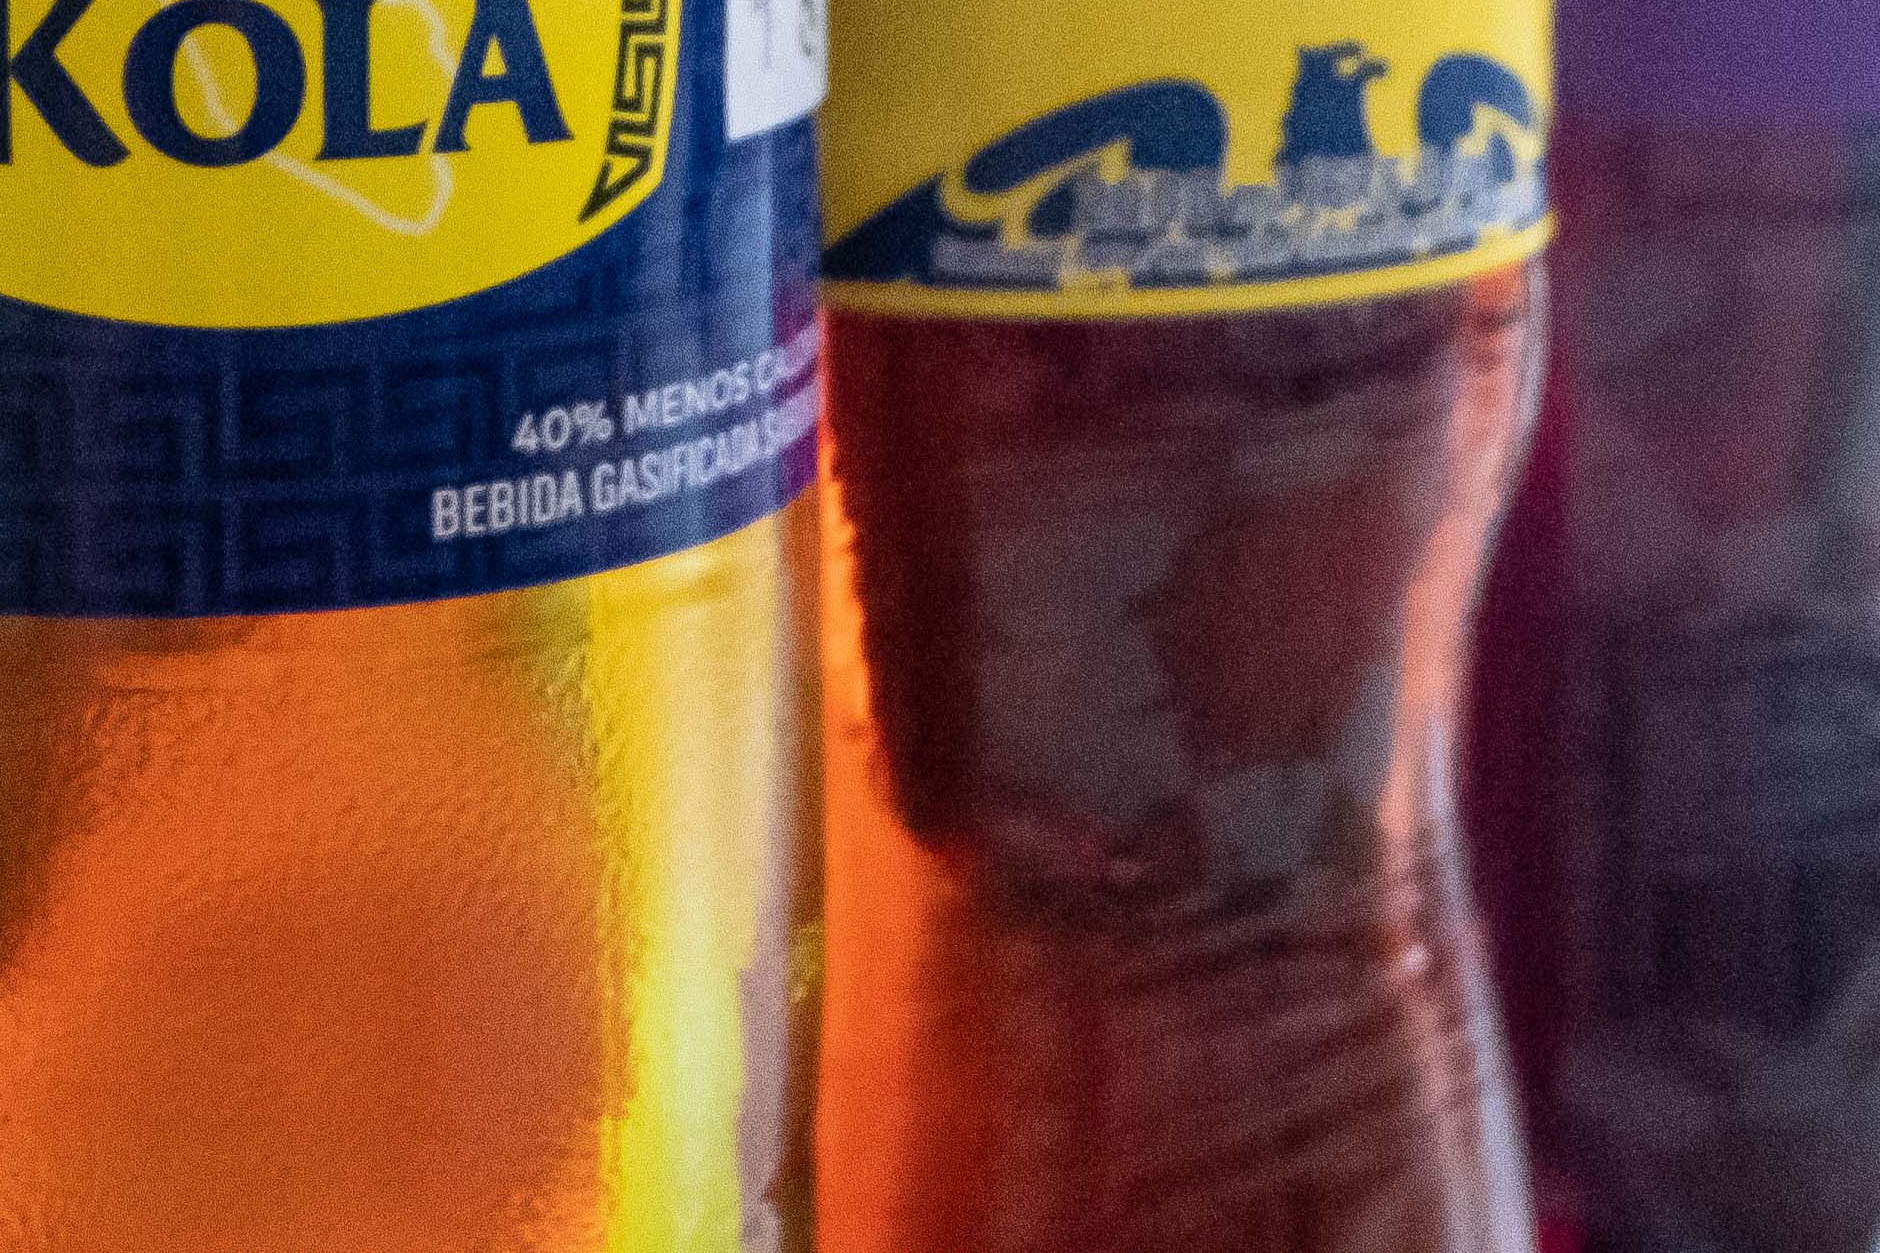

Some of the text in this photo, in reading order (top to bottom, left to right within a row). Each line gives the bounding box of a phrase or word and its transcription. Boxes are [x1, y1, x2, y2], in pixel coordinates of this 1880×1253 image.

[511, 399, 616, 454] 40%
[622, 361, 751, 435] MENOS
[431, 470, 585, 542] BEBIDA
